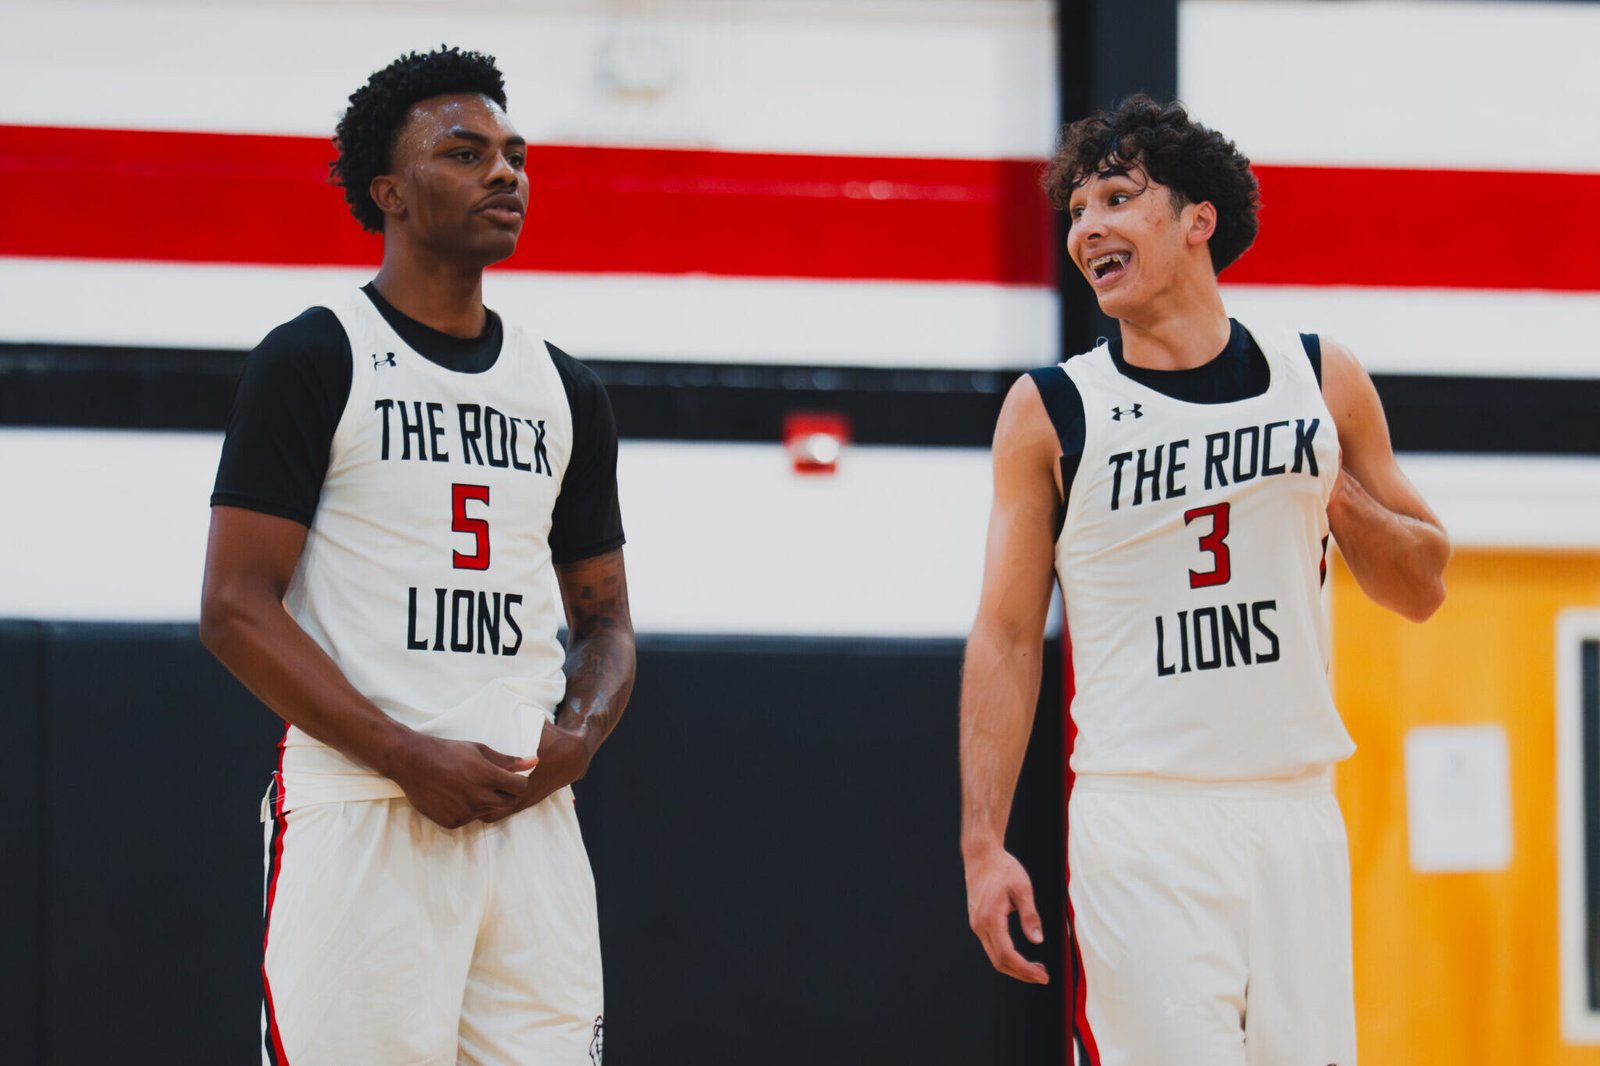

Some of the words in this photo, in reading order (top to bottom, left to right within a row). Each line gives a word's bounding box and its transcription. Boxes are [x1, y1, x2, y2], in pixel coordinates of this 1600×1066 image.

[374, 398, 450, 463] THE
[456, 403, 553, 478] ROCK
[1108, 438, 1190, 511] THE
[1203, 418, 1321, 491] ROCK
[451, 482, 491, 572] 5
[1184, 501, 1232, 590] 3
[407, 586, 523, 657] LIONS
[1155, 599, 1281, 677] LIONS
